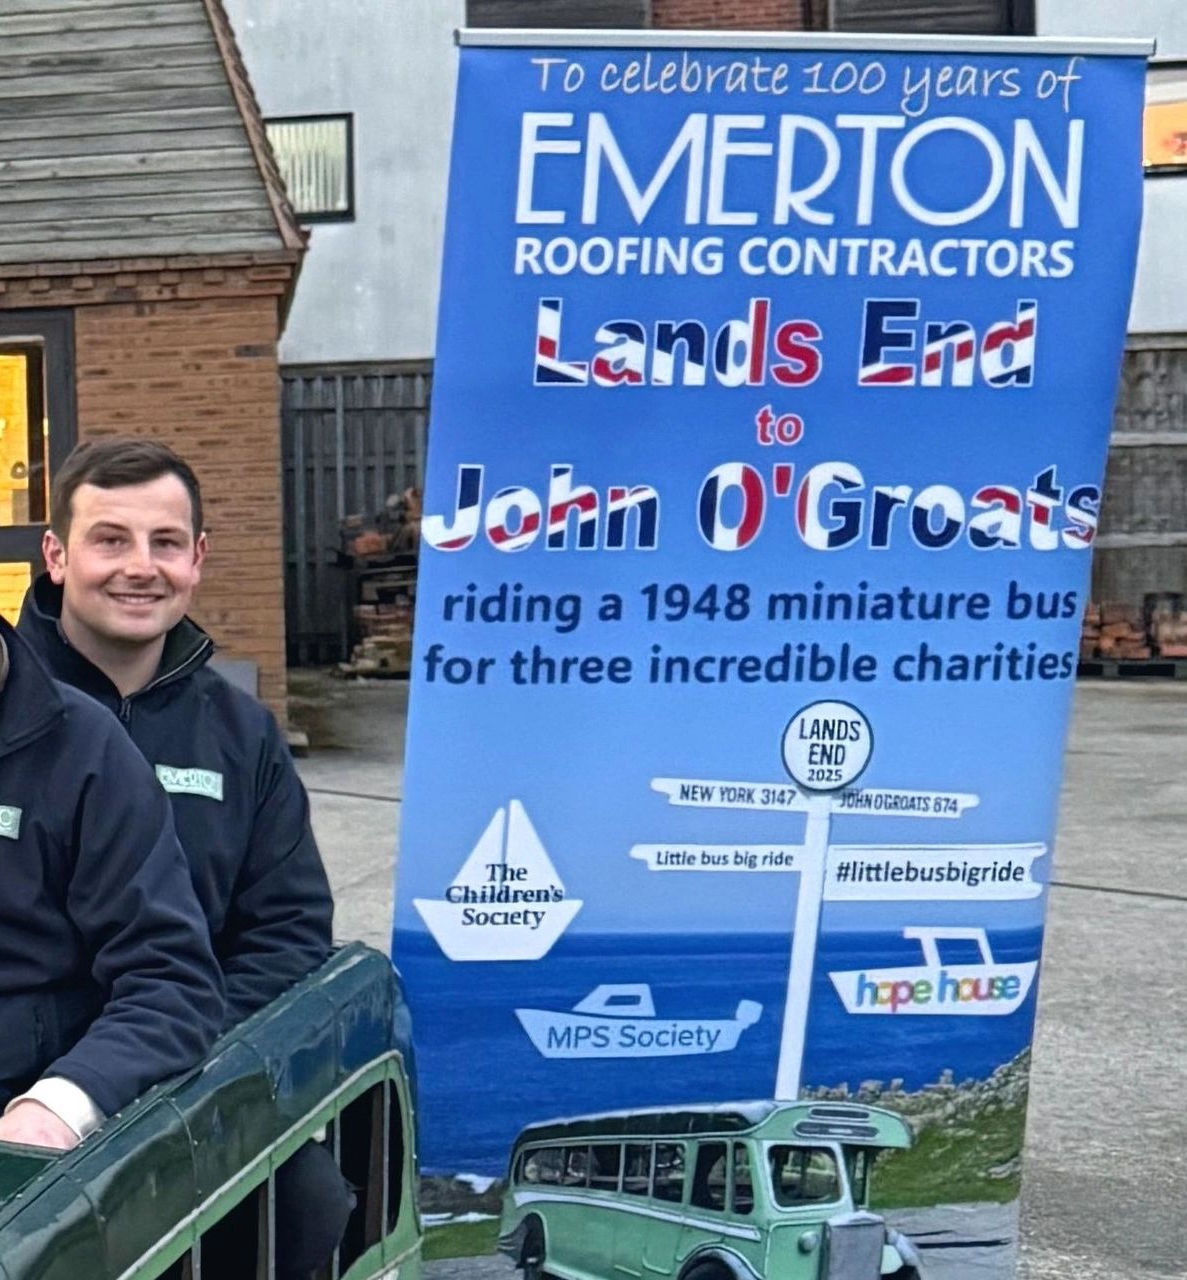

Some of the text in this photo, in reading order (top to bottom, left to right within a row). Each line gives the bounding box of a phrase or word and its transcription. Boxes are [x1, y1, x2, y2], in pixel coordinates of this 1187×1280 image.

[532, 53, 1084, 117] To celebrate 100 years of
[515, 112, 1083, 228] EMERTON
[515, 237, 1073, 277] ROOFING CONTRACTORS
[533, 298, 1037, 387] Lands End
[756, 405, 803, 446] to
[420, 461, 1100, 551] John O'Groats
[443, 582, 1076, 632] riding a 1948 miniature bus
[424, 643, 1072, 685] for three incredible charities
[799, 718, 861, 743] LANDS
[809, 743, 846, 768] END
[808, 769, 842, 783] 2025
[679, 783, 796, 806] NEW YORK 3147
[486, 864, 527, 882] The
[656, 851, 793, 870] Little bus big ride
[837, 859, 1025, 887] #littlebusbigride
[446, 884, 563, 904] Children's
[462, 907, 546, 929] Society
[856, 970, 1020, 1013] hope house
[547, 1024, 720, 1052] MPS Society
